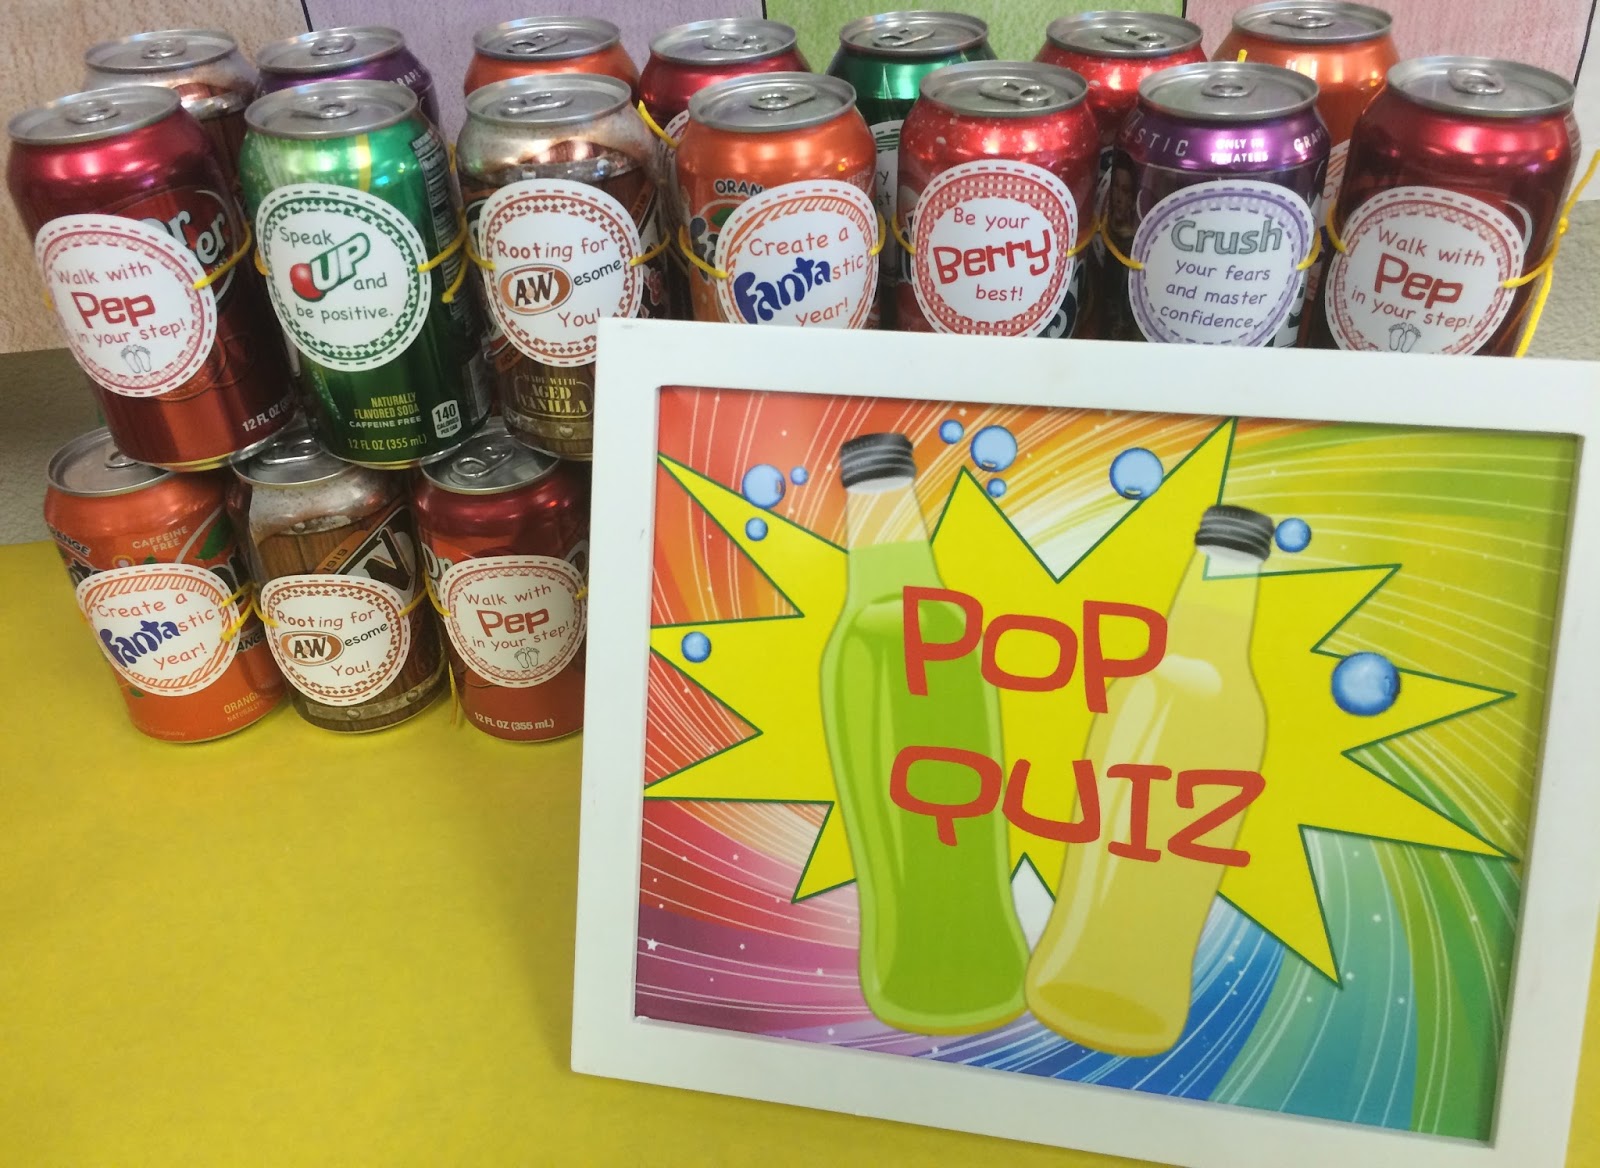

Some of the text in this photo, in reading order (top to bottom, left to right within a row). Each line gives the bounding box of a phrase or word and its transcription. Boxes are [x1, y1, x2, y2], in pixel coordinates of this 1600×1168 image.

[953, 206, 1030, 232] Be your
[279, 226, 335, 248] Speak
[749, 227, 849, 257] Create a
[1170, 218, 1283, 255] Crush
[1377, 225, 1486, 267] Walk with
[310, 232, 388, 292] UP and
[496, 237, 609, 262] Rooting for
[932, 229, 1051, 285] Berry
[56, 261, 152, 285] Walk with
[1175, 259, 1271, 281] your fears
[1374, 252, 1463, 309] Pep
[975, 283, 1024, 302] best!
[1165, 283, 1267, 306] and master
[71, 291, 156, 329] Pep
[296, 303, 394, 324] be positive.
[795, 297, 848, 327] year!
[1351, 285, 1473, 333] in your step!
[75, 317, 187, 347] in your step!
[532, 384, 572, 399] AGED
[549, 377, 576, 386] WITH
[353, 403, 420, 419] FLAVORED SODA
[370, 392, 416, 408] NATURALLY
[435, 403, 457, 422] 140
[520, 394, 588, 413] VANILLA
[242, 418, 257, 432] 12
[256, 412, 269, 426] FL
[269, 403, 281, 418] OZ
[349, 415, 422, 428] CAFFEINE FREE
[348, 438, 359, 449] 12
[360, 439, 371, 450] FL
[371, 439, 385, 450] OZ
[386, 437, 408, 450] (355
[132, 525, 189, 550] CAFFEINE
[152, 537, 182, 553] FREE
[95, 593, 188, 619] Create a
[463, 584, 552, 606] Walk with
[276, 608, 375, 630] Rooting for
[476, 608, 549, 637] Pep
[471, 621, 570, 652] in your step!
[903, 585, 1168, 713] POP
[153, 642, 207, 671] year!
[330, 660, 371, 677] You!
[474, 712, 555, 731] 12 FL OZ (355 mL)
[889, 745, 1267, 867] QUIZ
